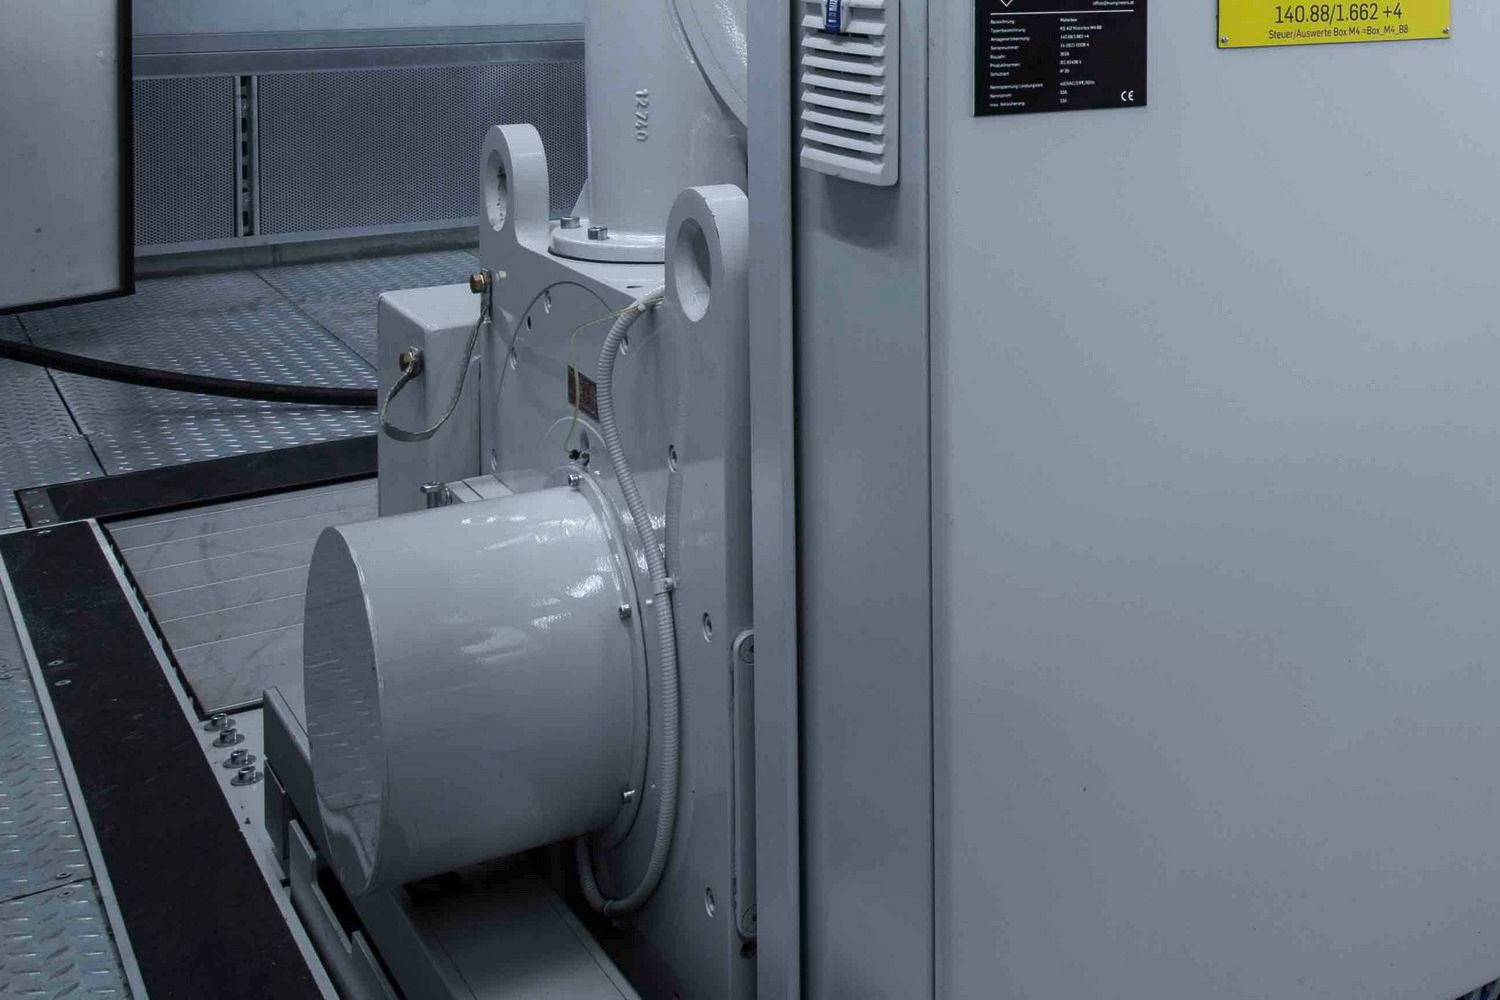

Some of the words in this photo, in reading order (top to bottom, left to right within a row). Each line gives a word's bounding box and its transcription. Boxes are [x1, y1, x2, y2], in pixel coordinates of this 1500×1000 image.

[1275, 2, 1378, 25] 140.88/1.662
[1383, 2, 1402, 20] +4
[1333, 26, 1347, 37] Box
[1348, 25, 1360, 36] M4
[1120, 90, 1134, 102] CE
